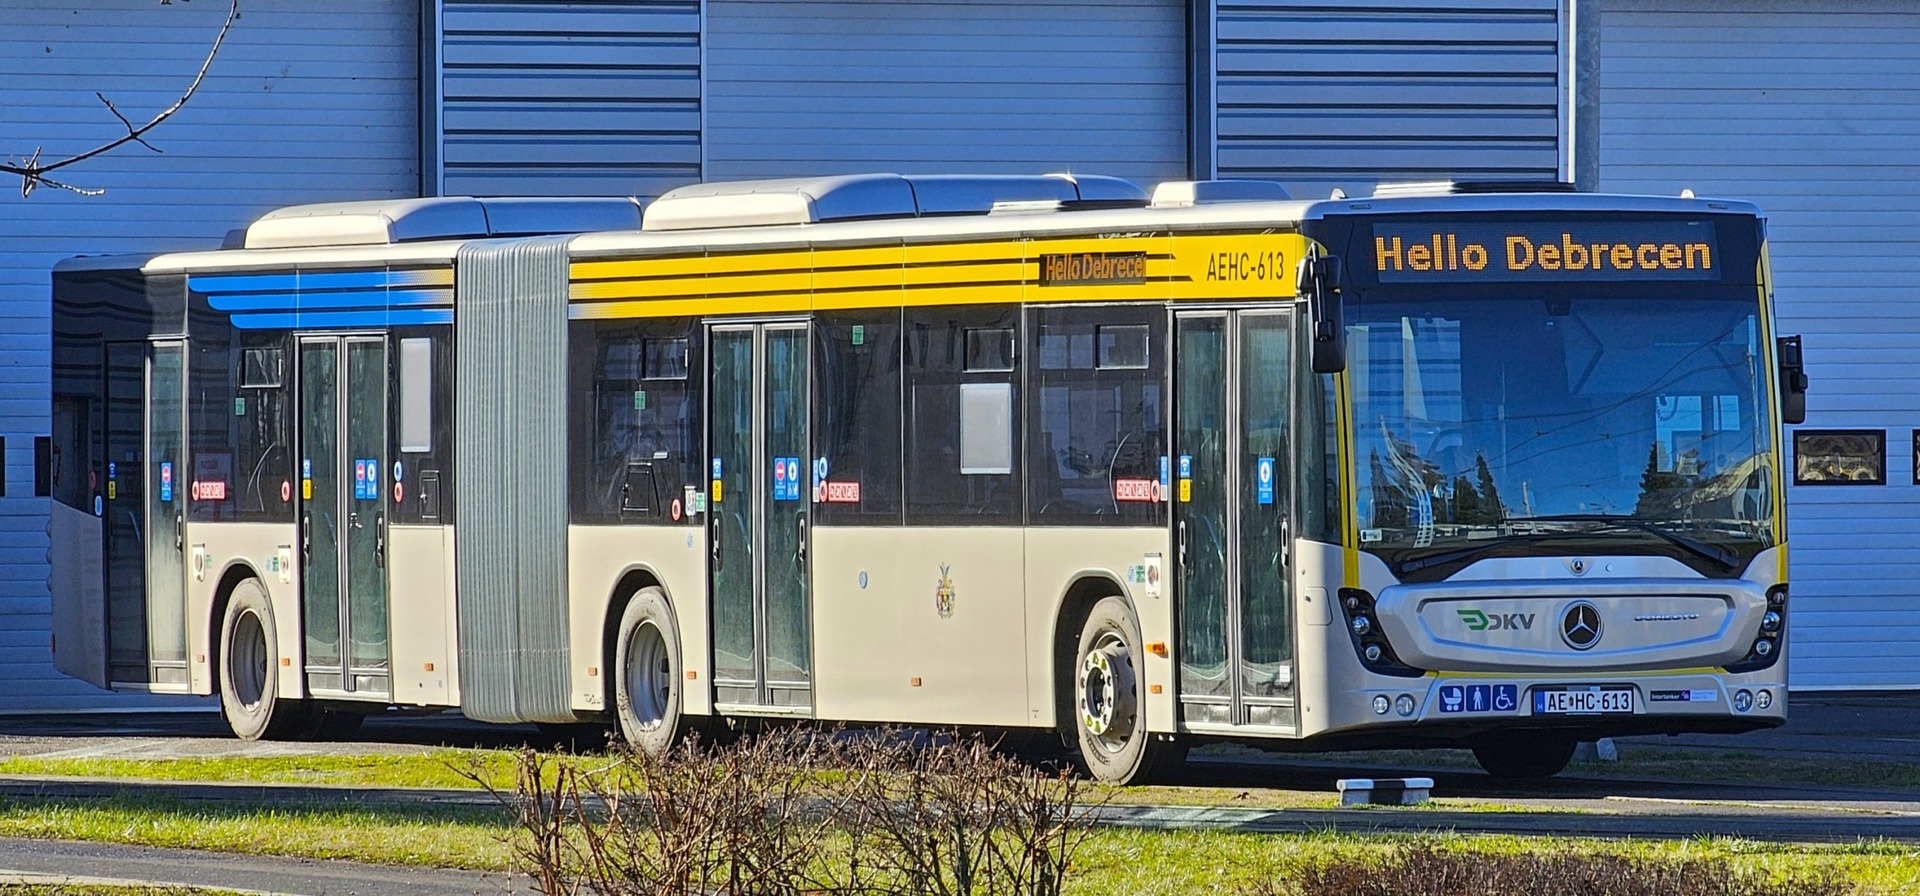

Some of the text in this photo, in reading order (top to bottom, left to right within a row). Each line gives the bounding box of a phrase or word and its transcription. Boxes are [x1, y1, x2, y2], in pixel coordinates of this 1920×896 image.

[1376, 233, 1712, 271] Hello Debrecen
[1046, 254, 1080, 280] Hello
[1206, 251, 1284, 281] AEHC-613
[1487, 613, 1536, 630] DKV
[1547, 692, 1629, 711] AE HC-613
